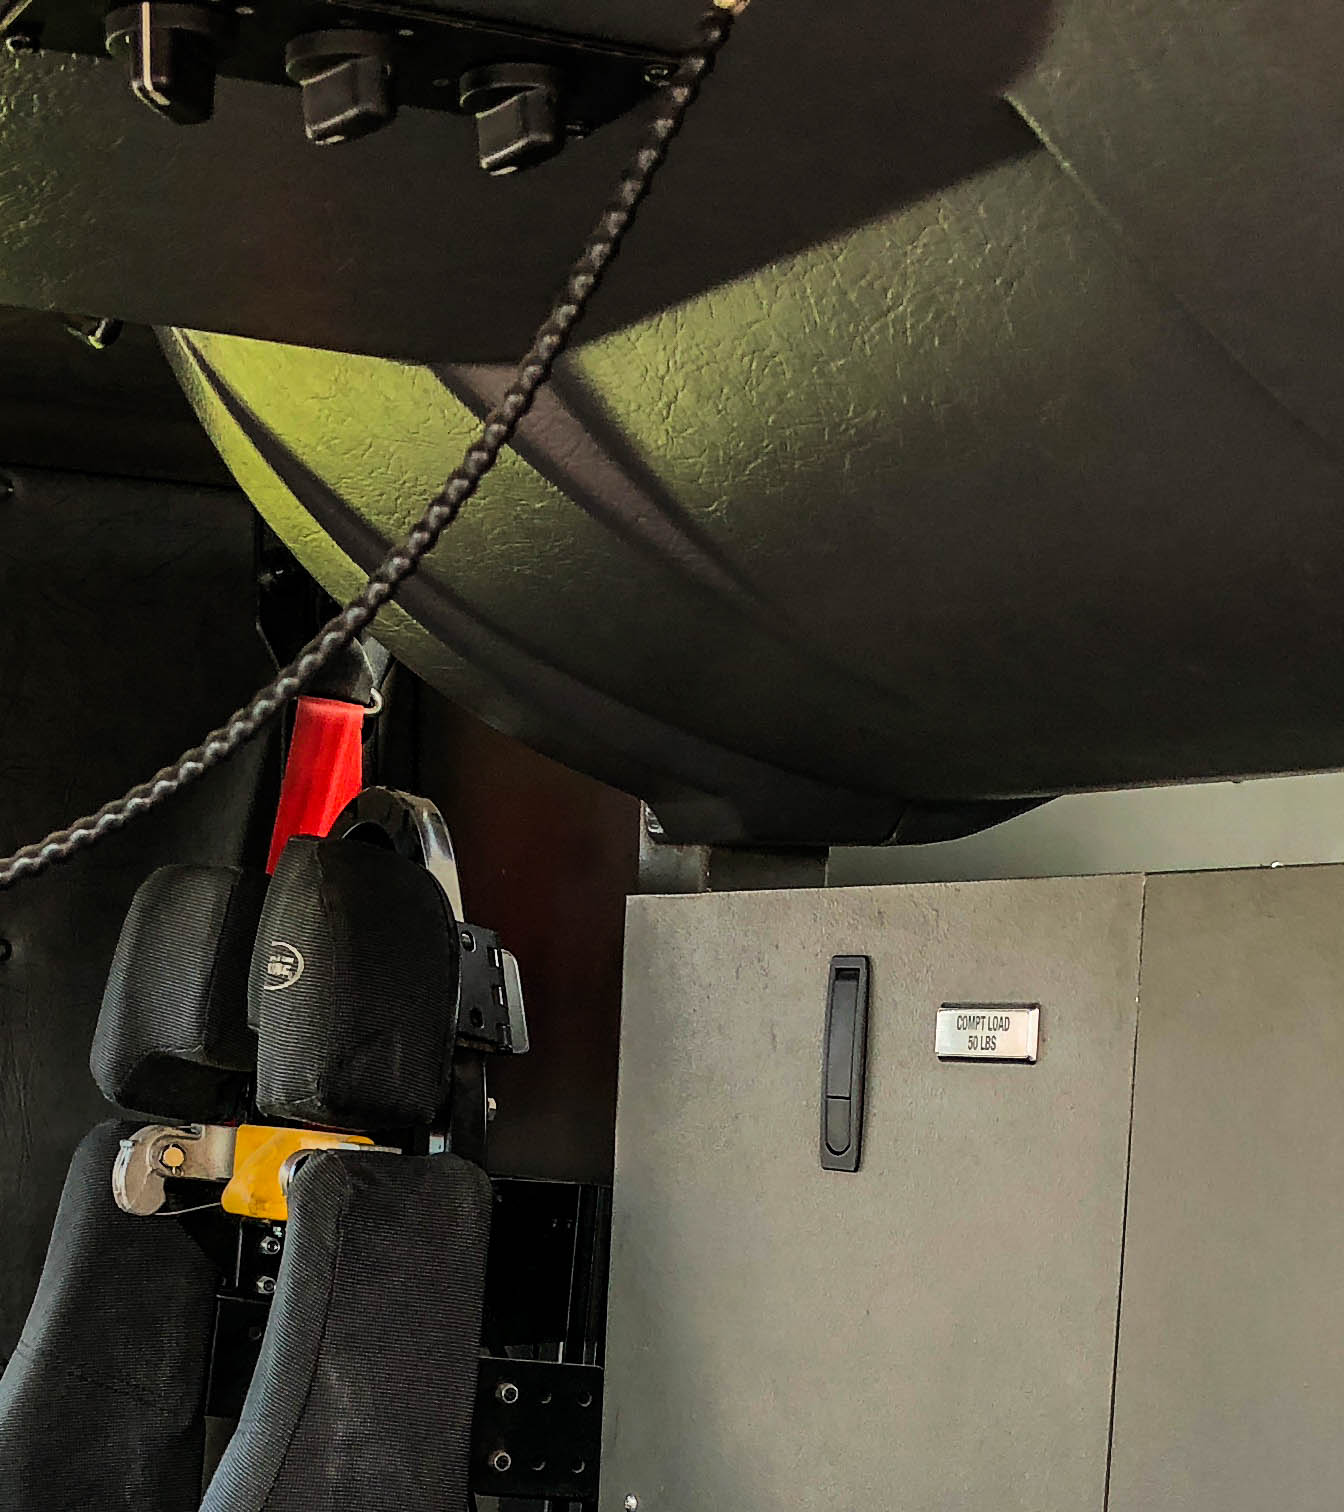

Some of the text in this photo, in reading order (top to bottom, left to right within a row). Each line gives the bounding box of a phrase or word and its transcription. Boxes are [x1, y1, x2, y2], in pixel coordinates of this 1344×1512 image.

[956, 1015, 1010, 1031] COMPT LOAD
[968, 1035, 997, 1050] 50 LBS
